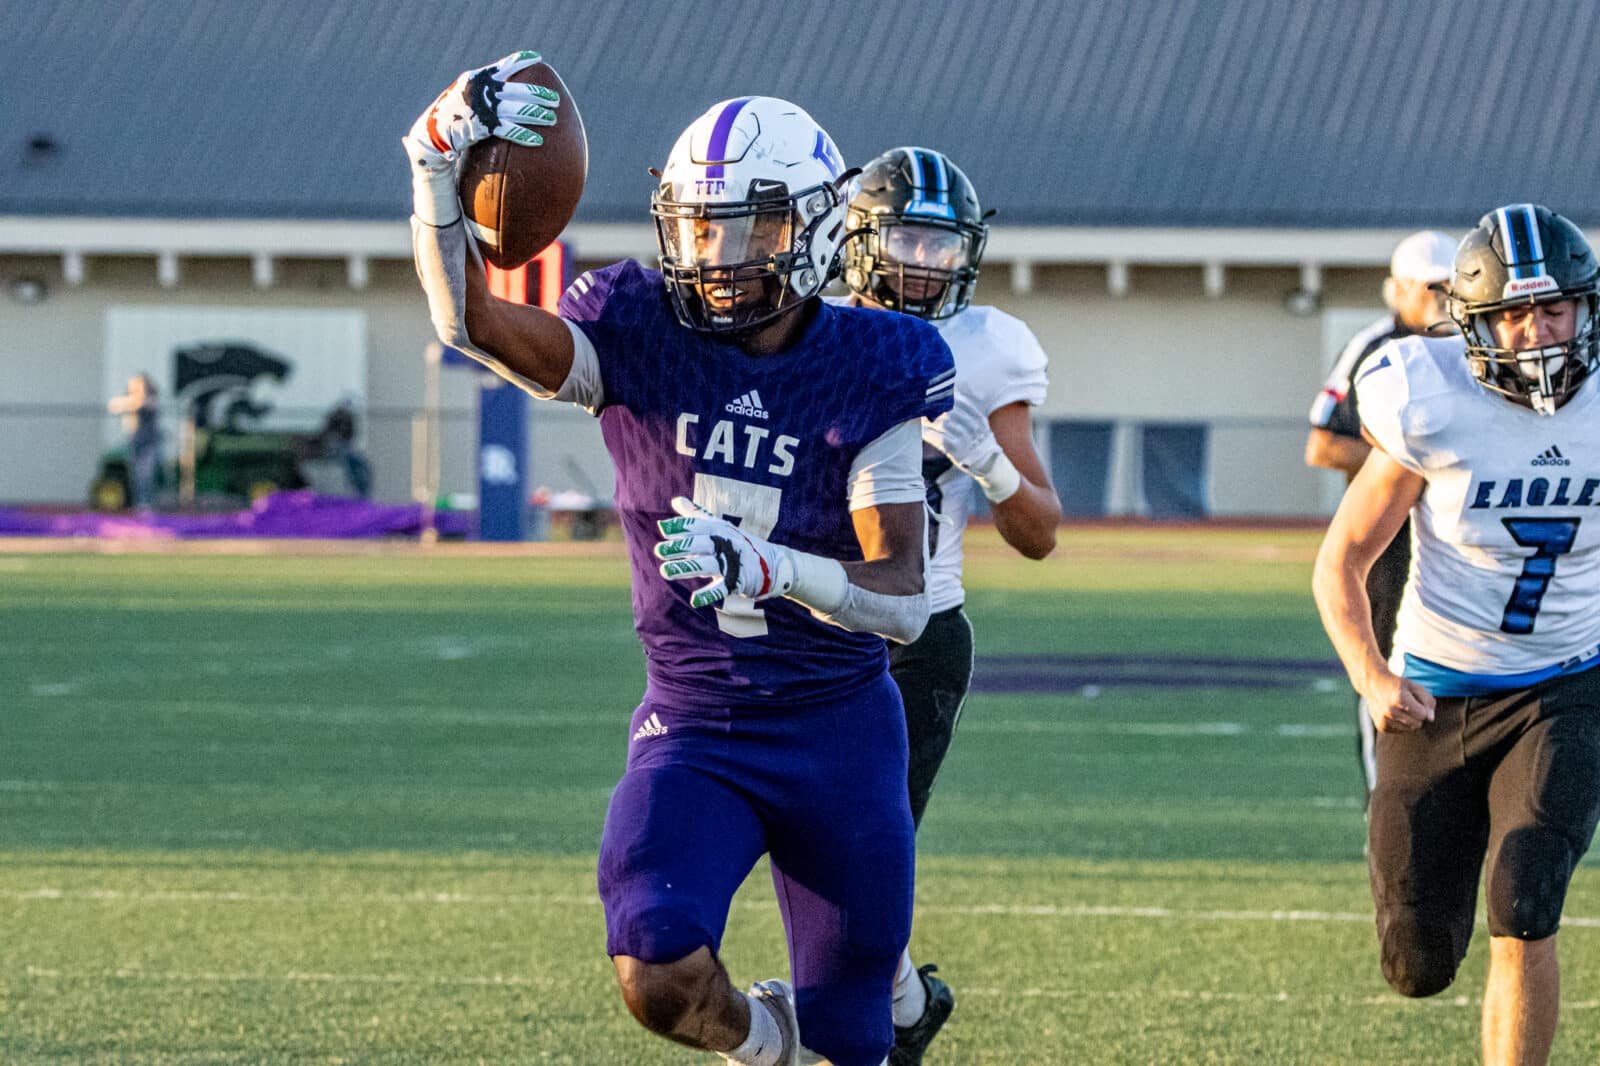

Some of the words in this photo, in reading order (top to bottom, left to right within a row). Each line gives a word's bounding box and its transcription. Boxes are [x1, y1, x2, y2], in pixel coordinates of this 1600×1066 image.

[725, 403, 769, 419] adidas
[676, 412, 800, 477] CATS
[1469, 477, 1600, 509] EAGLE
[1500, 516, 1582, 635] 7
